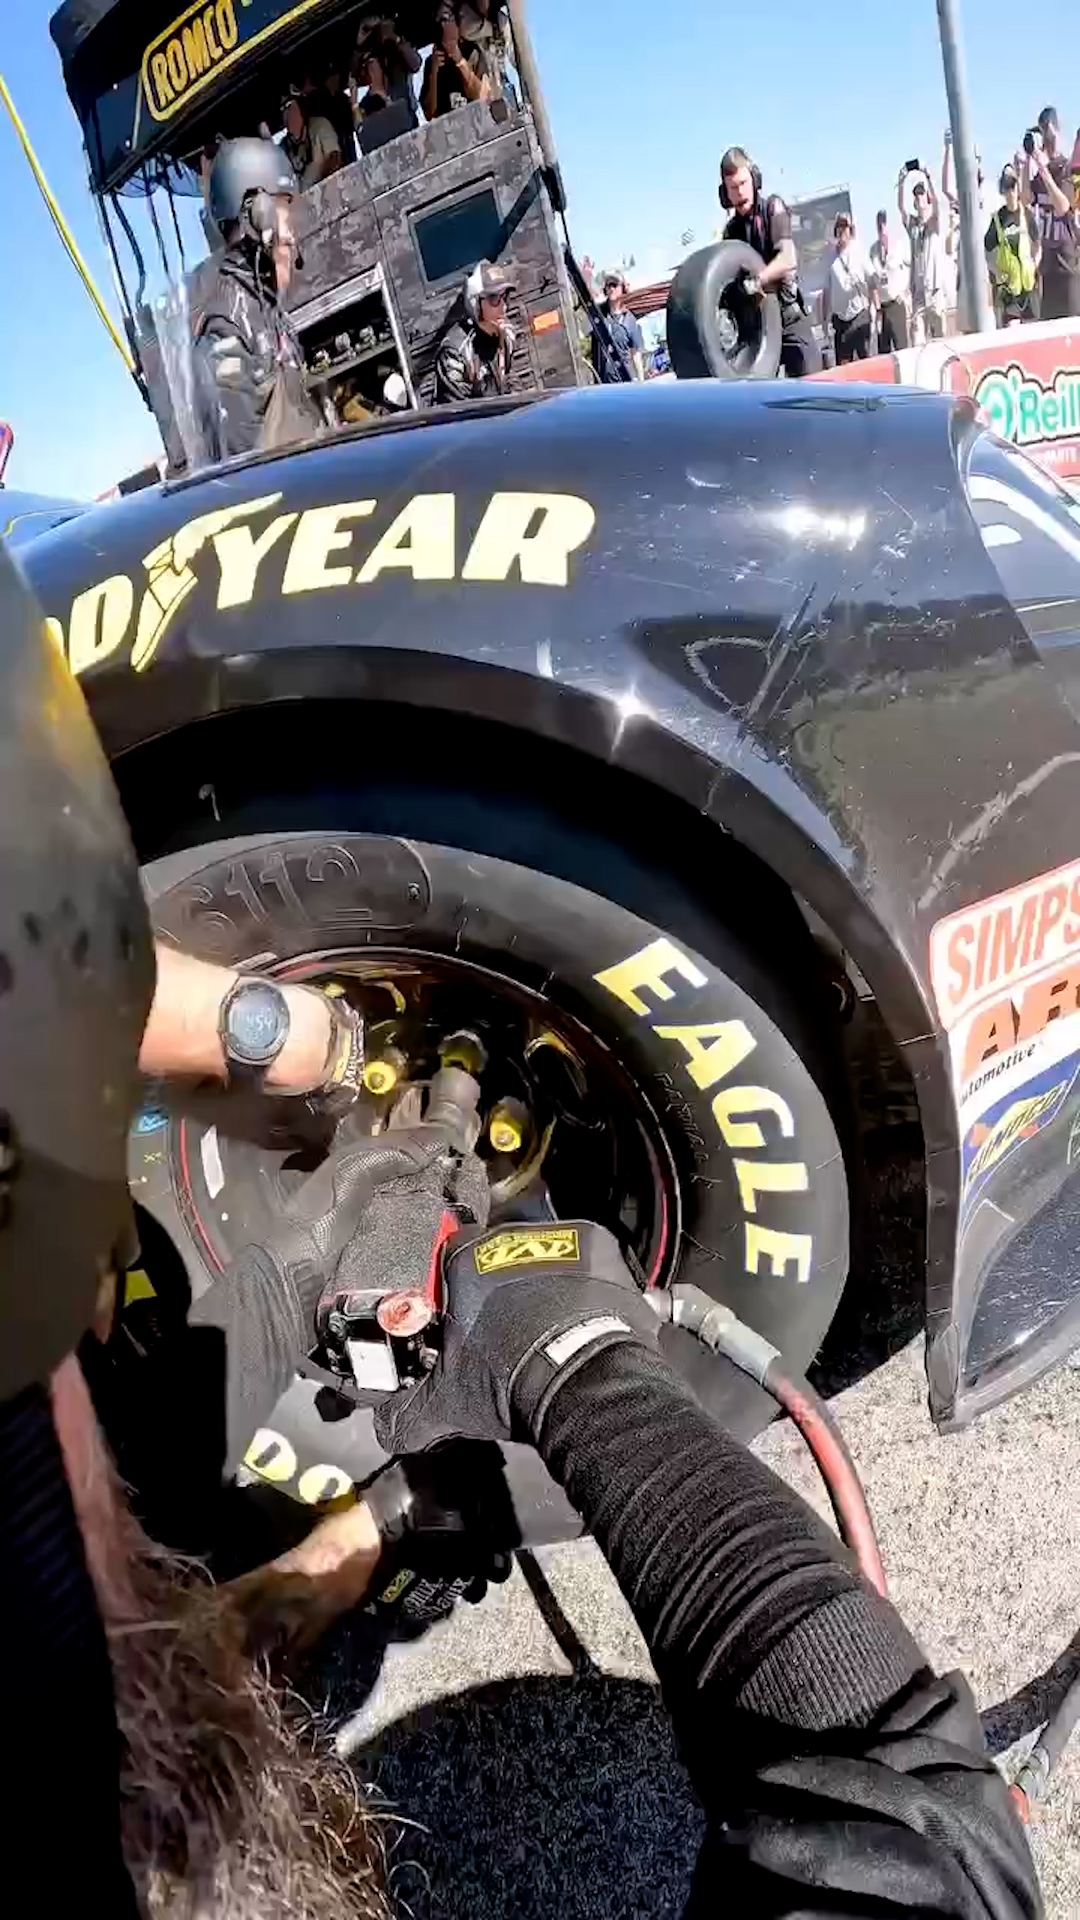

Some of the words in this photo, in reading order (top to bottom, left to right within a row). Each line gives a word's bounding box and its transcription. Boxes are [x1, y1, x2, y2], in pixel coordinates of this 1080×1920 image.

[151, 0, 238, 108] ROMCO
[45, 492, 596, 675] DYEAR
[592, 937, 813, 1284] EAGLE
[961, 1043, 1037, 1104] utomotive
